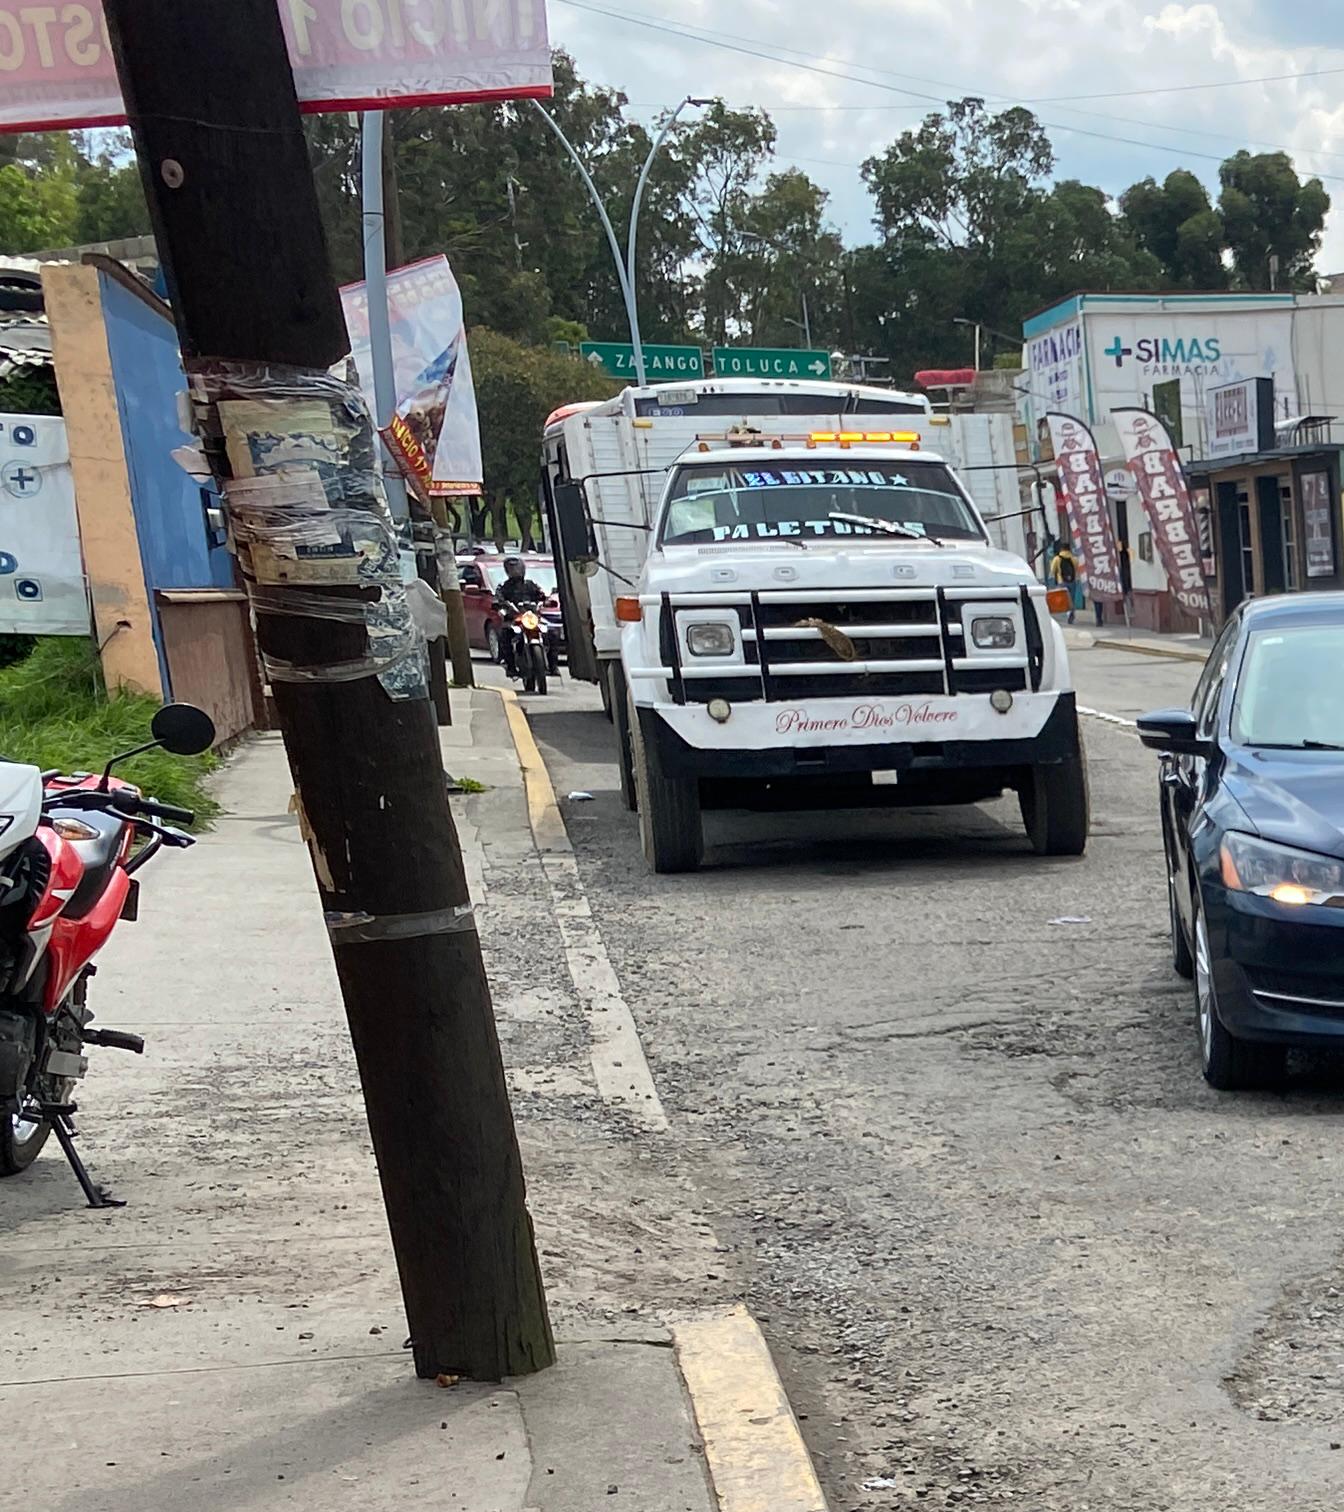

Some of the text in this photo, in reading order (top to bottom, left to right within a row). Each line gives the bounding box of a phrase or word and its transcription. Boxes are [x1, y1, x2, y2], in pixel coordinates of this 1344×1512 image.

[1135, 338, 1221, 363] SIMAS
[718, 357, 799, 373] TOLUCA
[1143, 364, 1220, 376] FARMACIA
[743, 470, 779, 486] EL
[775, 708, 848, 735] Primero
[851, 704, 894, 729] Dios
